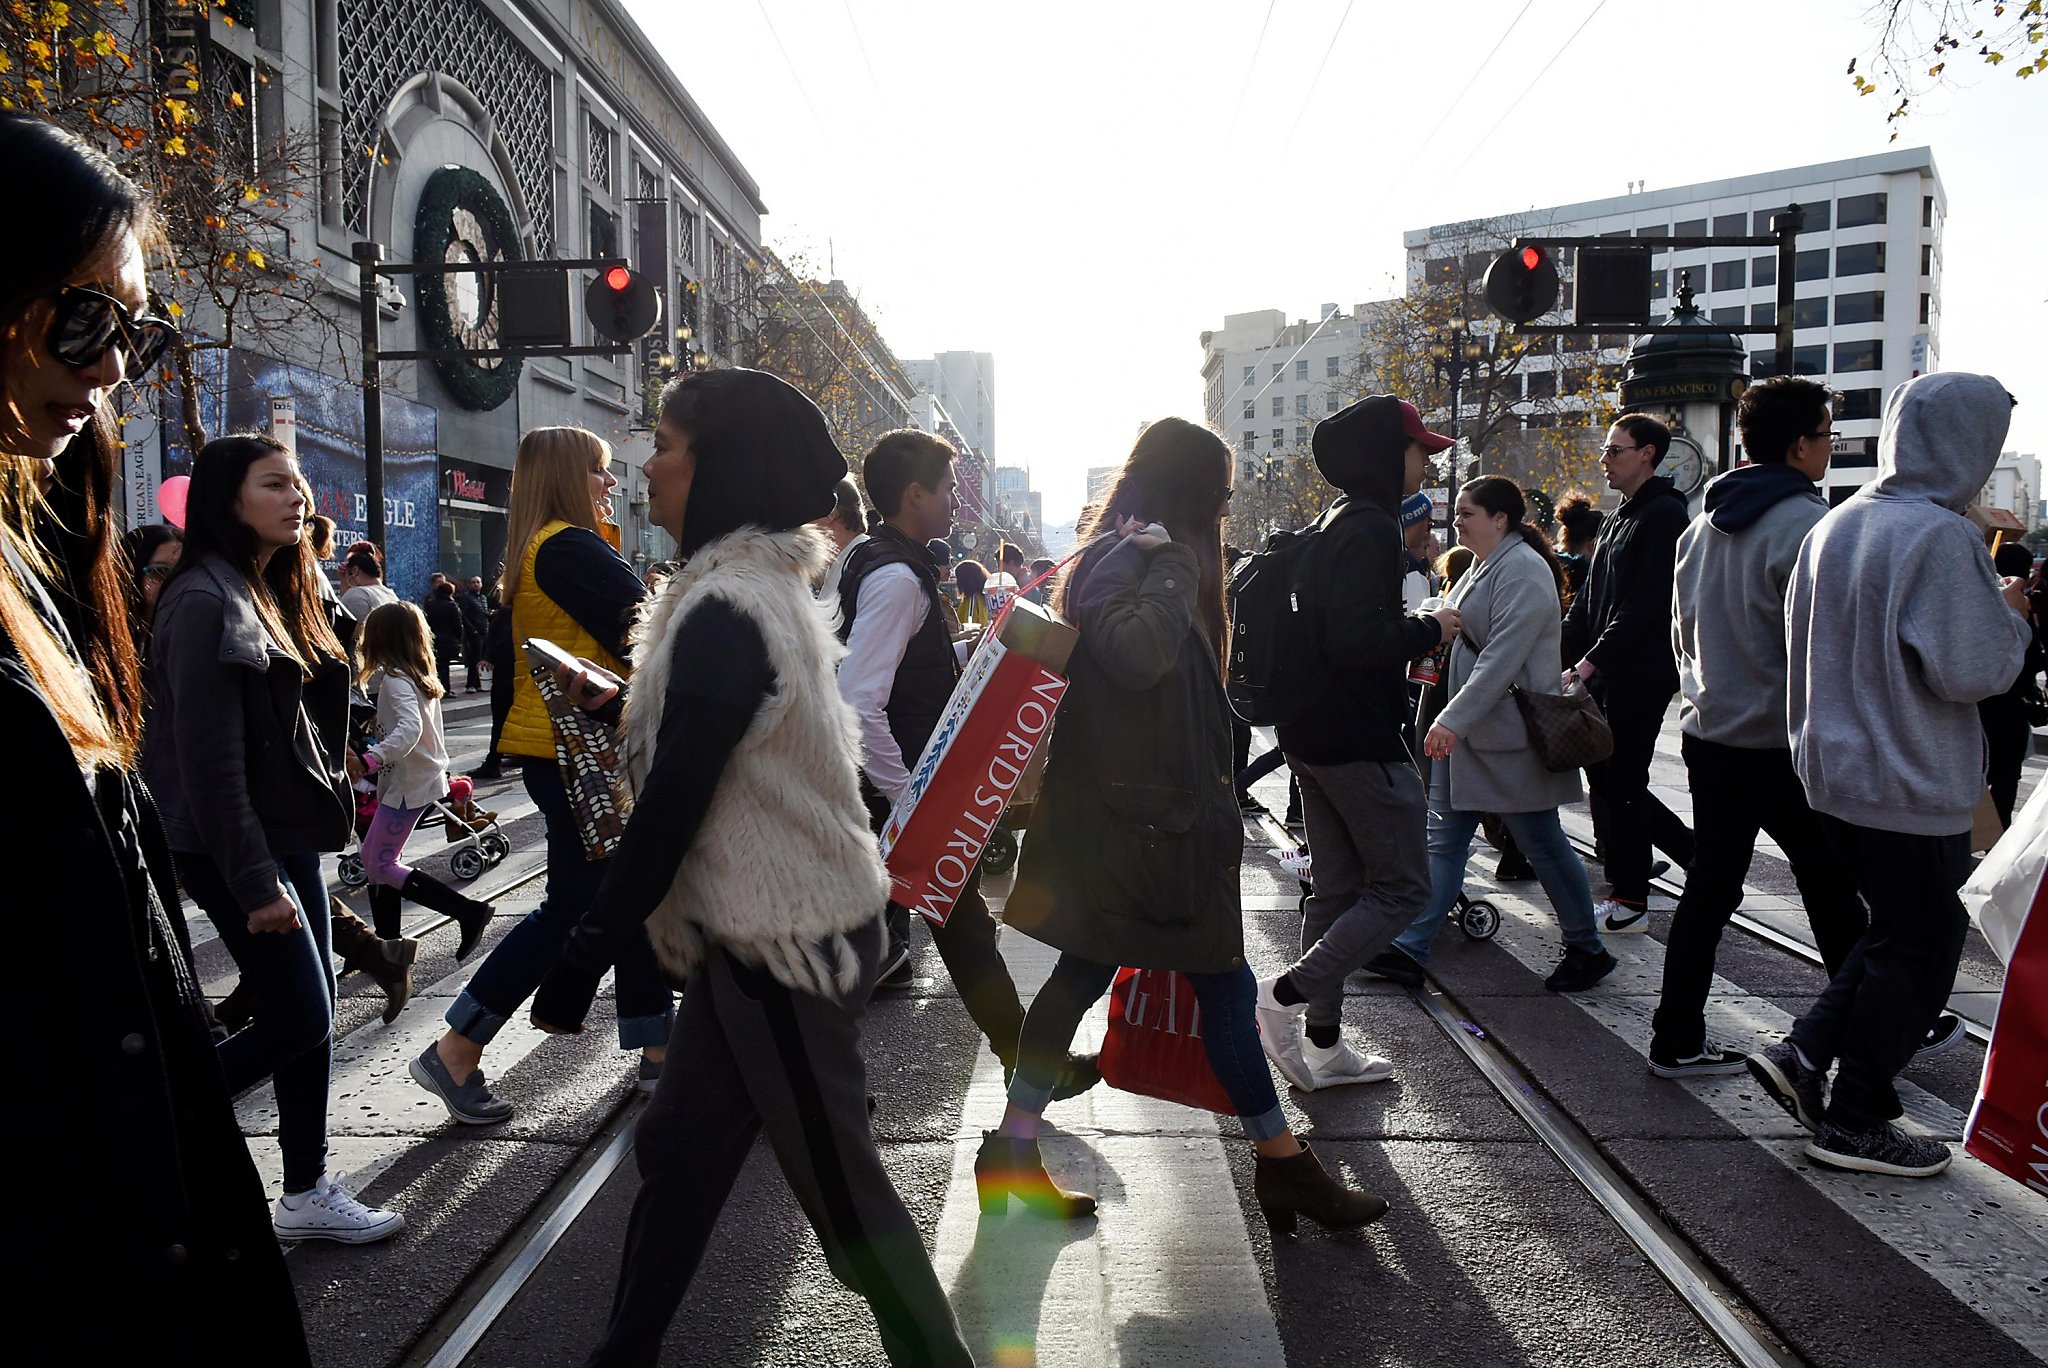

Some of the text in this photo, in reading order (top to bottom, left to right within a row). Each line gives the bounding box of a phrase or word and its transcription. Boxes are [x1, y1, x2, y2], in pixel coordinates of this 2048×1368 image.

[1634, 383, 1717, 398] SAN FRANCISCO
[133, 439, 146, 479] EAGLE
[452, 470, 486, 499] Westfield
[354, 493, 416, 528] EGLE
[915, 669, 1066, 925] NORDSTROM
